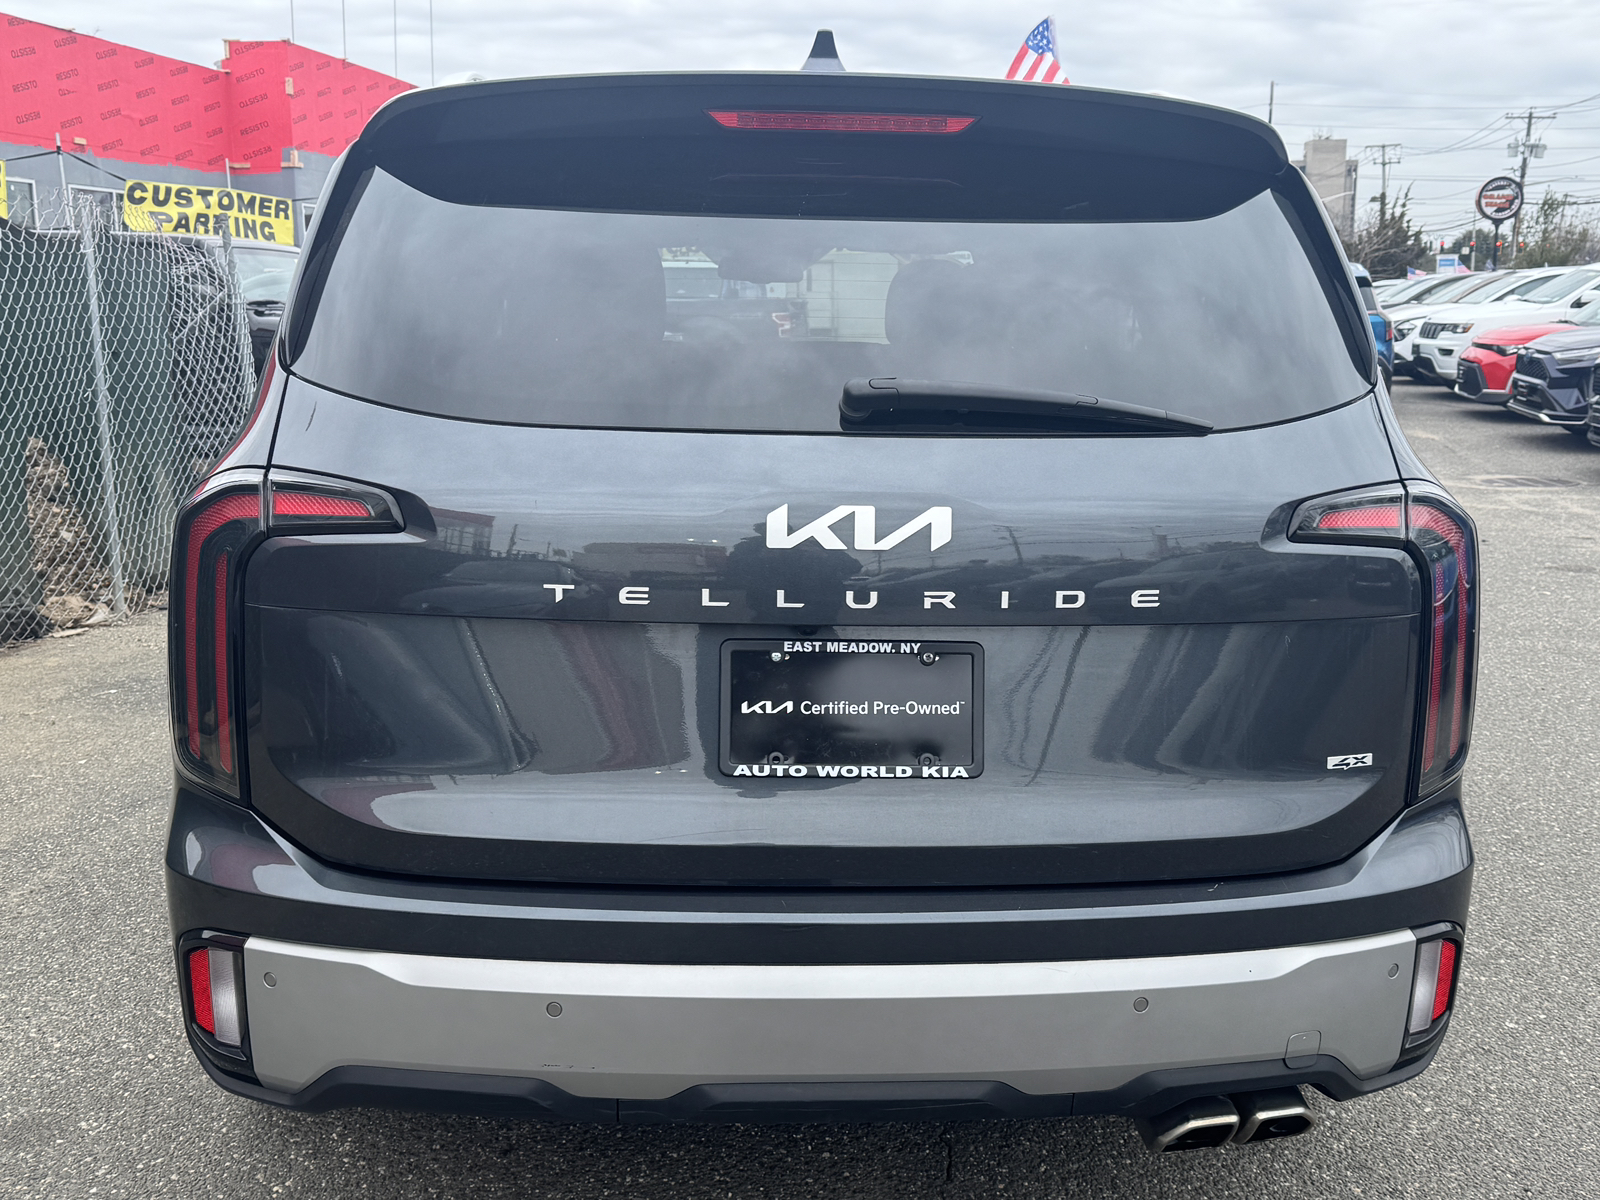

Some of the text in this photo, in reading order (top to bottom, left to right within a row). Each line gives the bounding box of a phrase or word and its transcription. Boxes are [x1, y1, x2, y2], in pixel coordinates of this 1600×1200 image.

[11, 47, 36, 58] RESISTO
[56, 68, 79, 81] RESISTO
[236, 68, 265, 84] RESISTO
[12, 80, 38, 93] RESISTO
[239, 93, 268, 108] RESISTO
[16, 112, 41, 124] RESISTO
[240, 121, 269, 136] RESISTO
[243, 146, 272, 160] RESISTO
[126, 182, 290, 220] CUSTOMER
[543, 584, 1161, 610] TELLURIDE
[783, 641, 822, 652] EAST
[900, 643, 922, 653] NY
[800, 701, 869, 715] Certified
[733, 765, 969, 778] AUTO WORLD KIA
